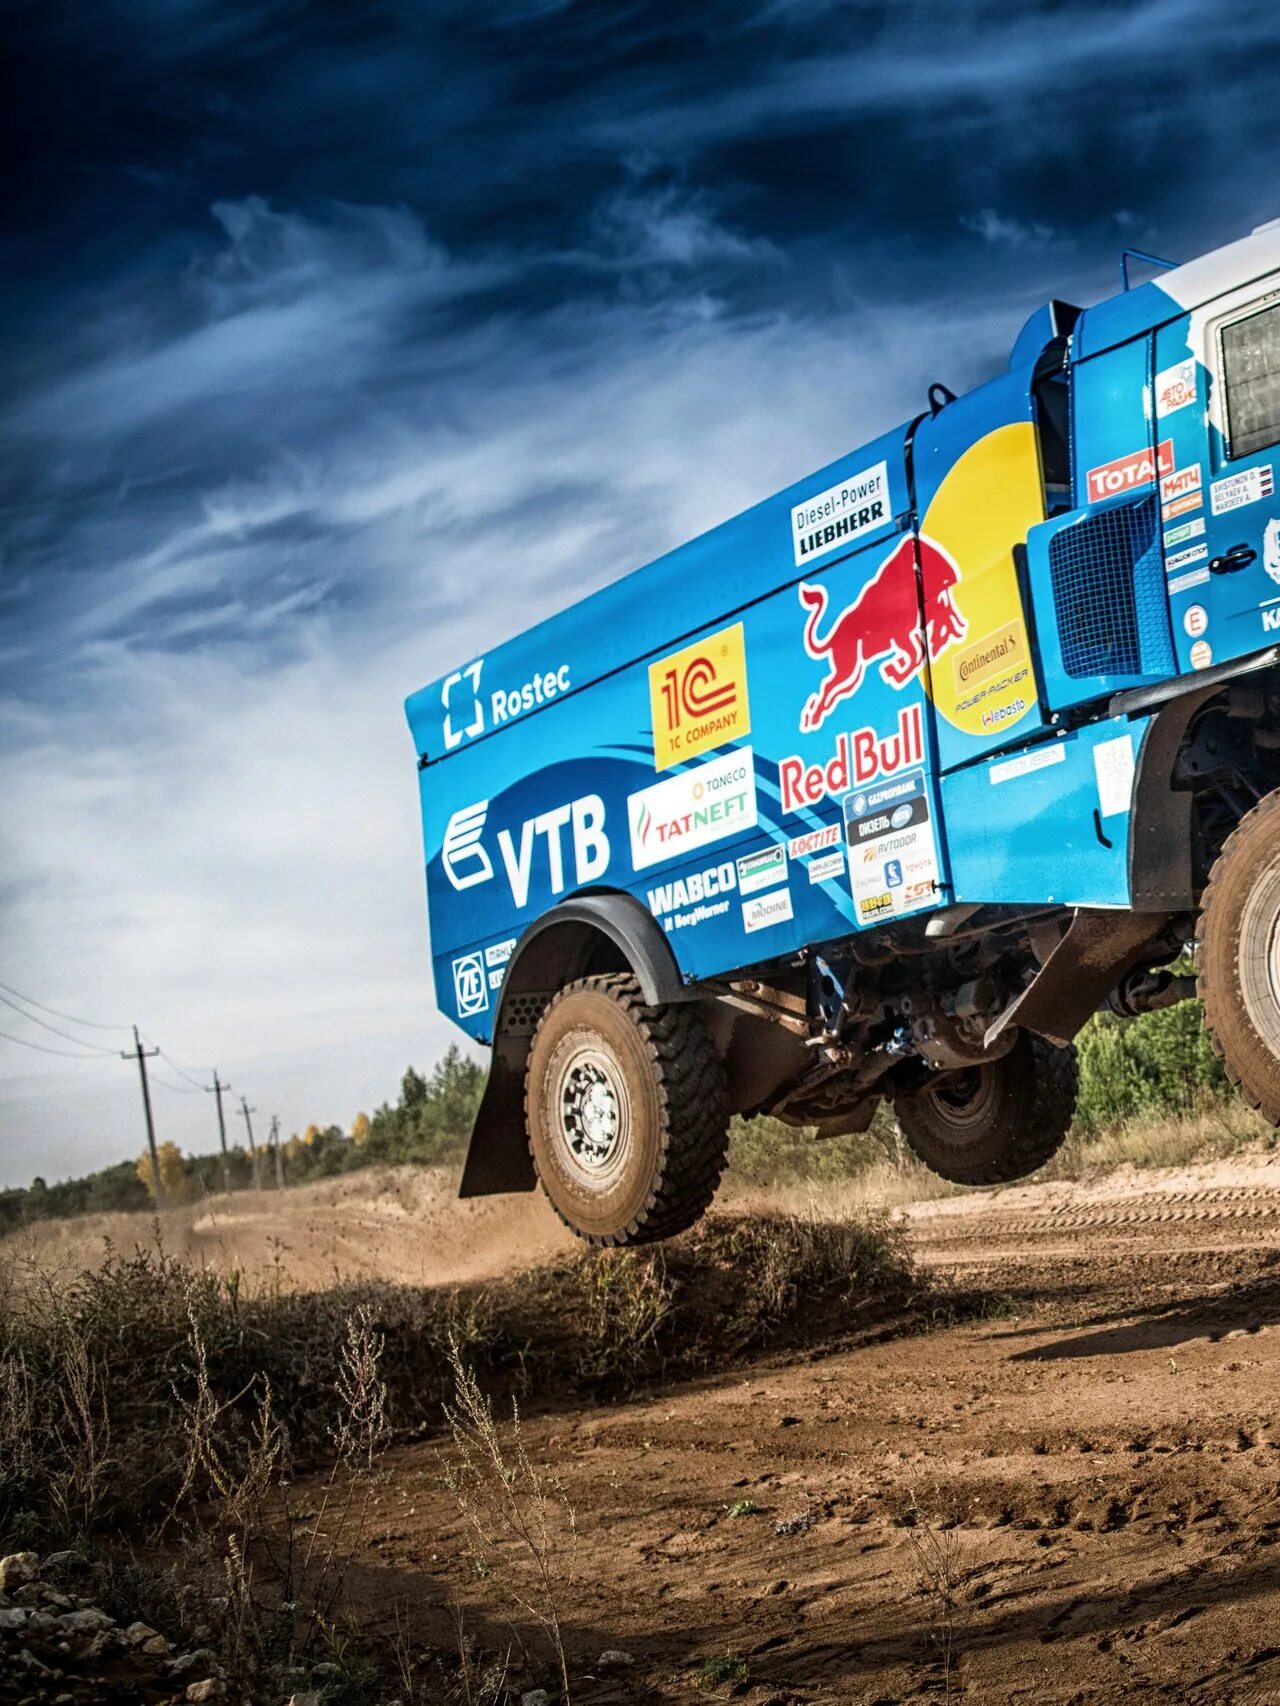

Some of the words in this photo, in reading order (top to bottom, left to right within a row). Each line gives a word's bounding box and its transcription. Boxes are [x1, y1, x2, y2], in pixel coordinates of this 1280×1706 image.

[1090, 455, 1171, 494] TOTAL
[797, 476, 880, 529] Diesel-Power
[800, 501, 884, 556] LIEBHERR
[959, 637, 1009, 681] Continental
[491, 664, 570, 725] Rostec
[955, 669, 1028, 713] POWER-PACKER
[686, 710, 738, 744] COMPANY
[982, 699, 1025, 727] Webasto
[781, 736, 848, 810] Red
[854, 707, 922, 782] Bull
[655, 791, 748, 843] TATNEFT
[497, 793, 611, 909] VTB
[791, 826, 838, 857] LOCTITE
[878, 833, 916, 854] AVTODOR
[905, 859, 932, 873] TOYOTA
[647, 862, 736, 917] WABCO
[751, 900, 788, 920] MODINE
[674, 900, 730, 928] BorgWarner
[459, 967, 482, 1003] ZF
